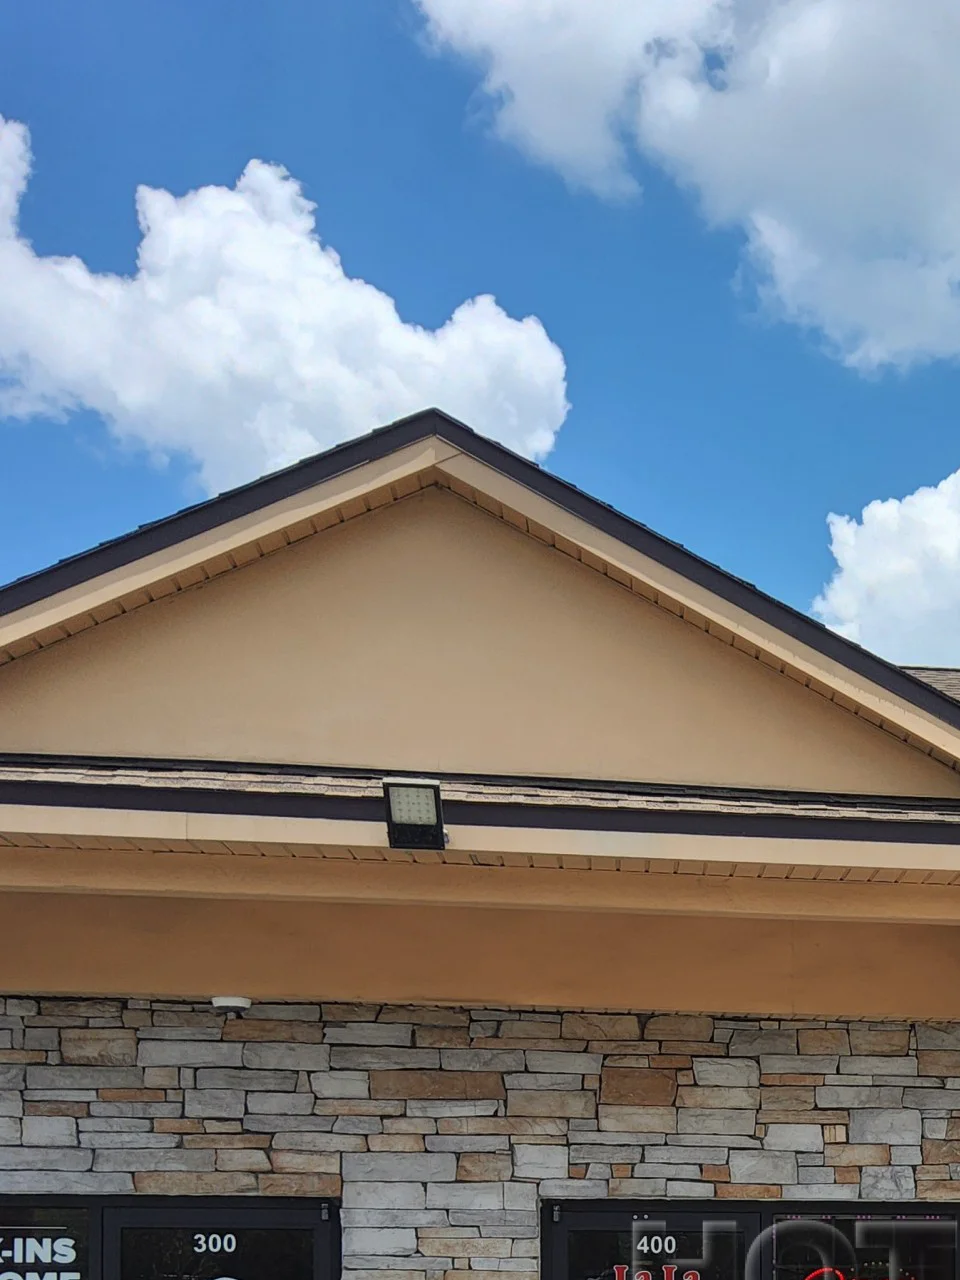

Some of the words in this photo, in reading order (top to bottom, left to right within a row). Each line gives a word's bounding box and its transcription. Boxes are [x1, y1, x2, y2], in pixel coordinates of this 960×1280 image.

[0, 1237, 77, 1264] -INS
[193, 1234, 236, 1253] 300
[636, 1236, 677, 1253] 400
